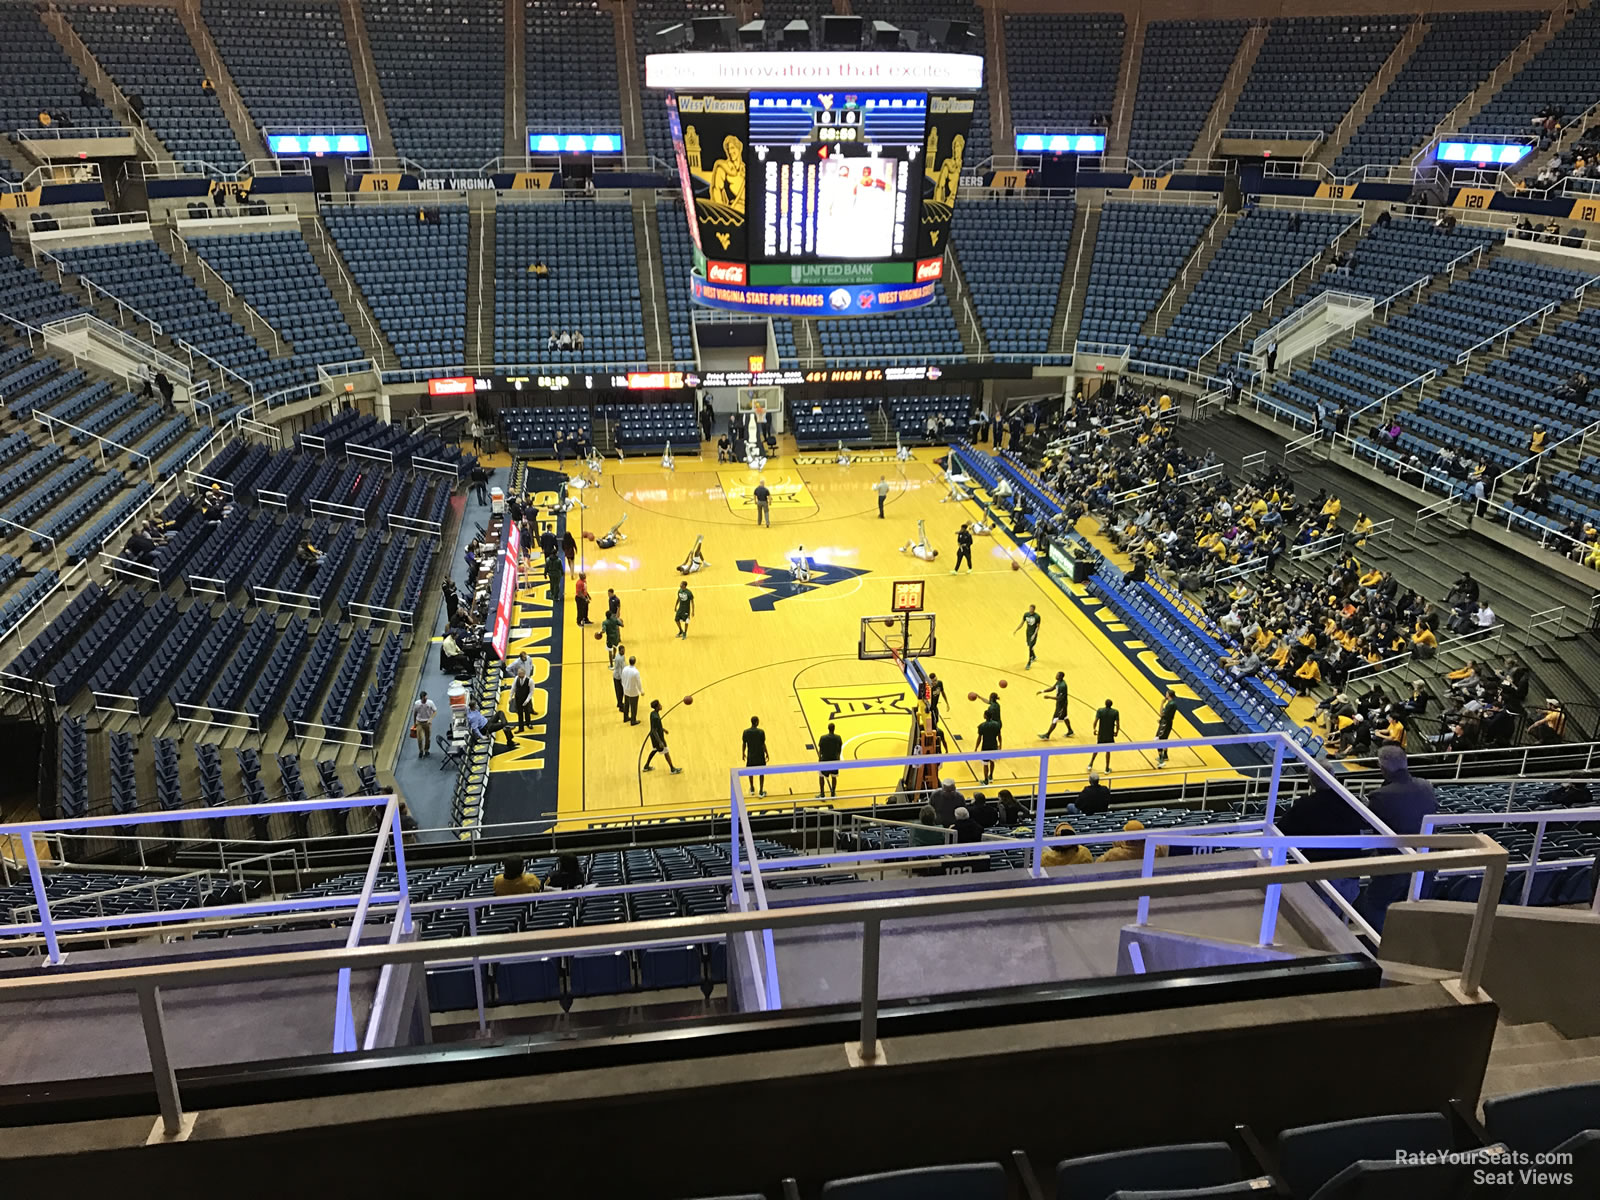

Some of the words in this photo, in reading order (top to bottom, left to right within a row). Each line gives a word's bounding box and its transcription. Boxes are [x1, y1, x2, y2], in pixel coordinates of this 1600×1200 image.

[718, 63, 830, 77] Innovation
[839, 63, 880, 77] that
[889, 64, 951, 77] excites
[821, 111, 831, 123] 0
[846, 111, 856, 123] 0
[372, 179, 389, 191] 113
[418, 179, 446, 190] WEST
[449, 178, 496, 190] VIRGINIA
[525, 178, 541, 189] 114
[1003, 176, 1017, 187] 117
[1142, 179, 1157, 190] 118
[1328, 186, 1344, 199] 119
[14, 194, 28, 208] 111
[1465, 195, 1484, 208] 120
[1581, 206, 1597, 221] 121
[802, 264, 843, 276] UNITED
[844, 263, 874, 275] BANK
[703, 285, 716, 299] WEST
[717, 287, 745, 303] VIRGINIA
[746, 291, 769, 305] STATE
[769, 293, 789, 306] PIPE
[790, 294, 824, 307] TRADES
[878, 292, 898, 304] WEST
[831, 370, 862, 381] HIGH
[865, 369, 883, 380] ST.
[850, 455, 916, 464] VIRGINA
